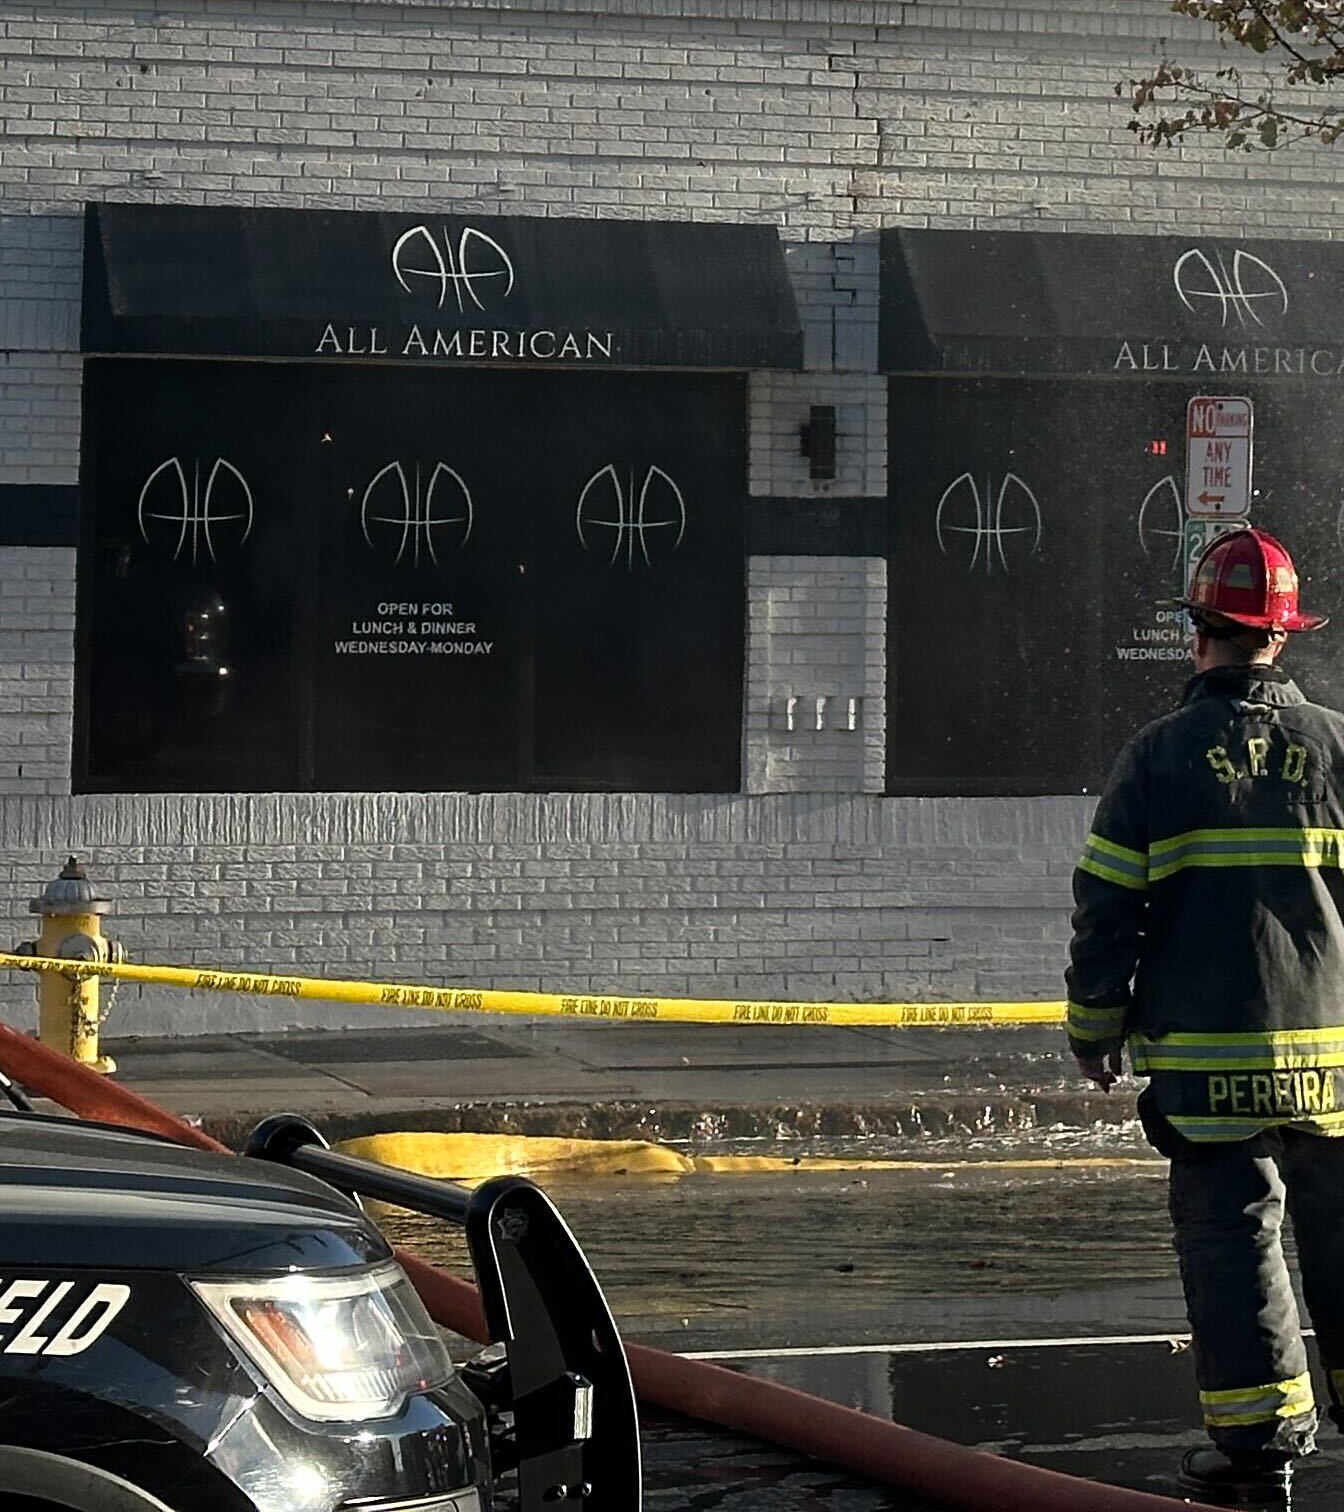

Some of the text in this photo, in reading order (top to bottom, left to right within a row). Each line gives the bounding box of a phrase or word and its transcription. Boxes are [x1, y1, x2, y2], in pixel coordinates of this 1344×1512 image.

[315, 323, 614, 359] ALL AMERICAN
[1113, 341, 1179, 371] ALL
[1193, 404, 1216, 434] NO
[1206, 441, 1232, 462] ANY
[1203, 466, 1232, 488] TIME
[377, 602, 453, 616] OPEN FOR
[1156, 611, 1185, 623] OPE
[352, 621, 476, 635] LUNCH & DINNER
[1132, 628, 1180, 641] LUNCH
[1116, 648, 1194, 661] WEDNESDA
[238, 977, 251, 991] DO
[1208, 1071, 1336, 1115] PEREIRA
